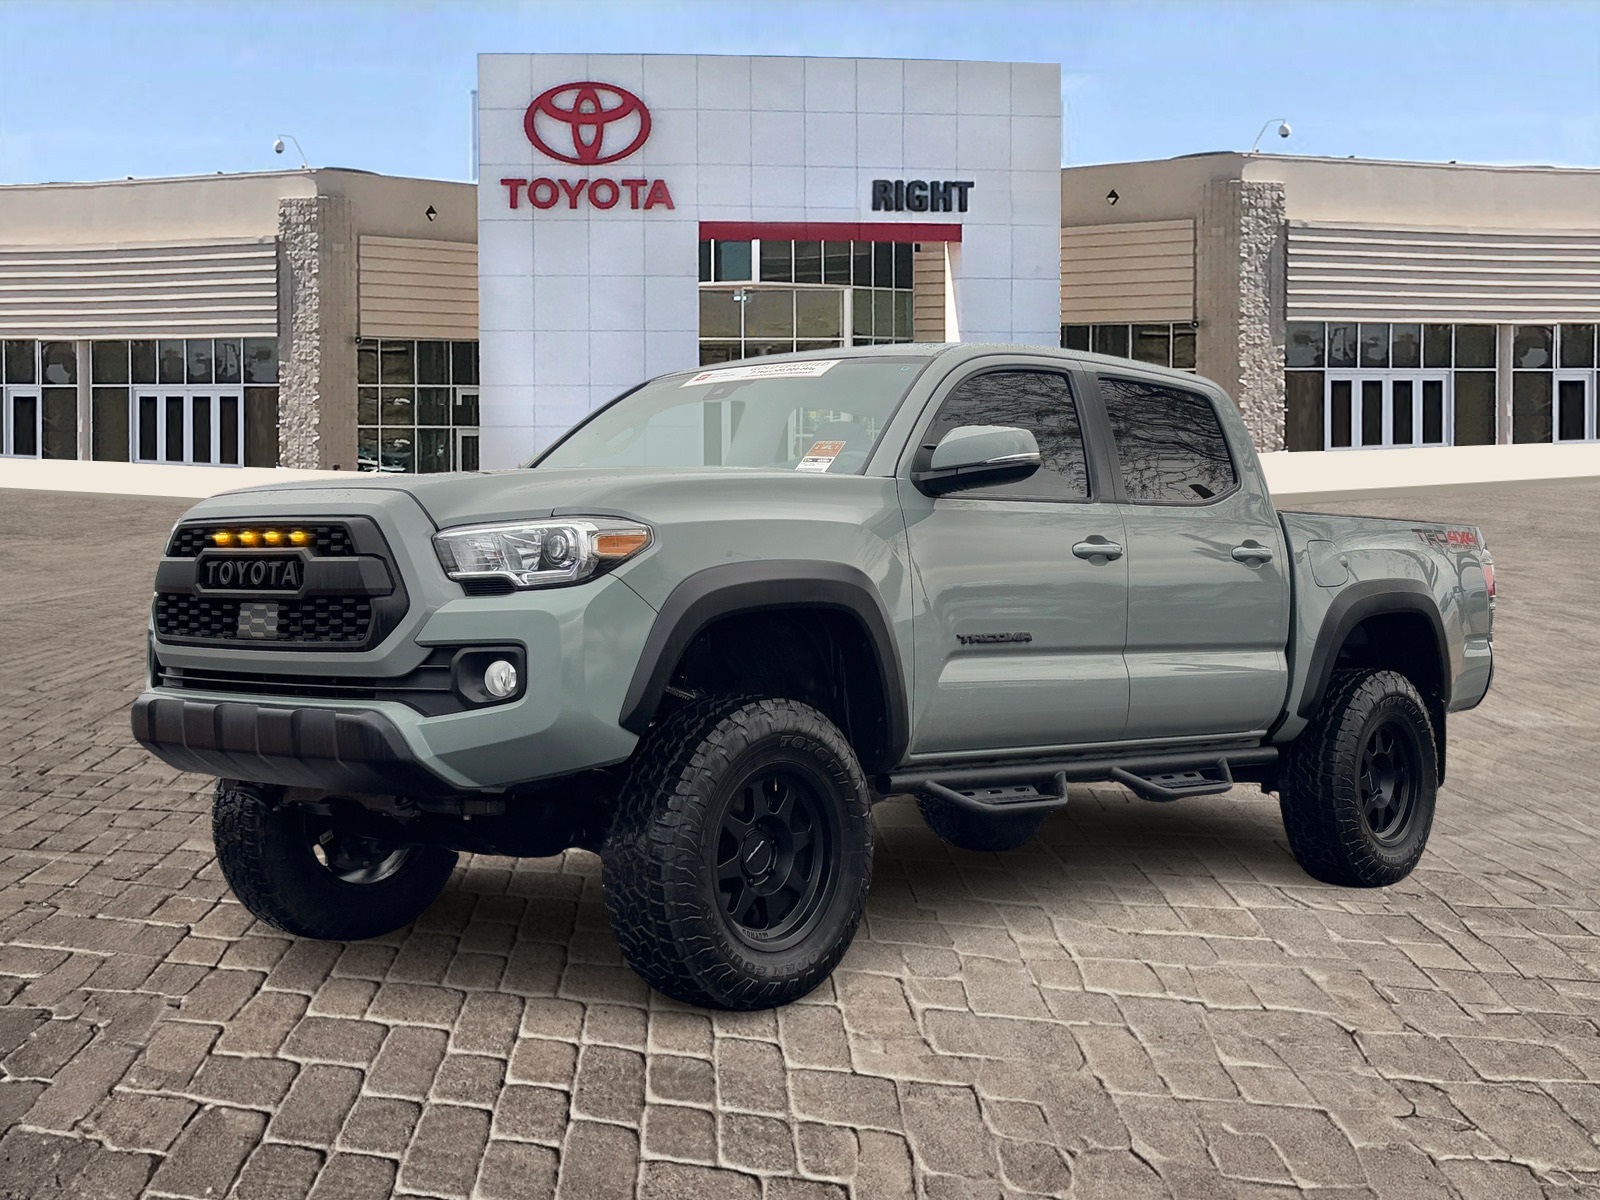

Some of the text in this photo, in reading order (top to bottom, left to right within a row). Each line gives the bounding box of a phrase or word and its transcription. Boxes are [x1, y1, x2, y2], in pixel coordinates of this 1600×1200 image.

[500, 177, 675, 210] TOYOTA
[872, 179, 975, 212] RIGHT
[1411, 528, 1448, 547] TRD
[206, 560, 301, 586] TOYOTA
[780, 735, 830, 760] TOYO
